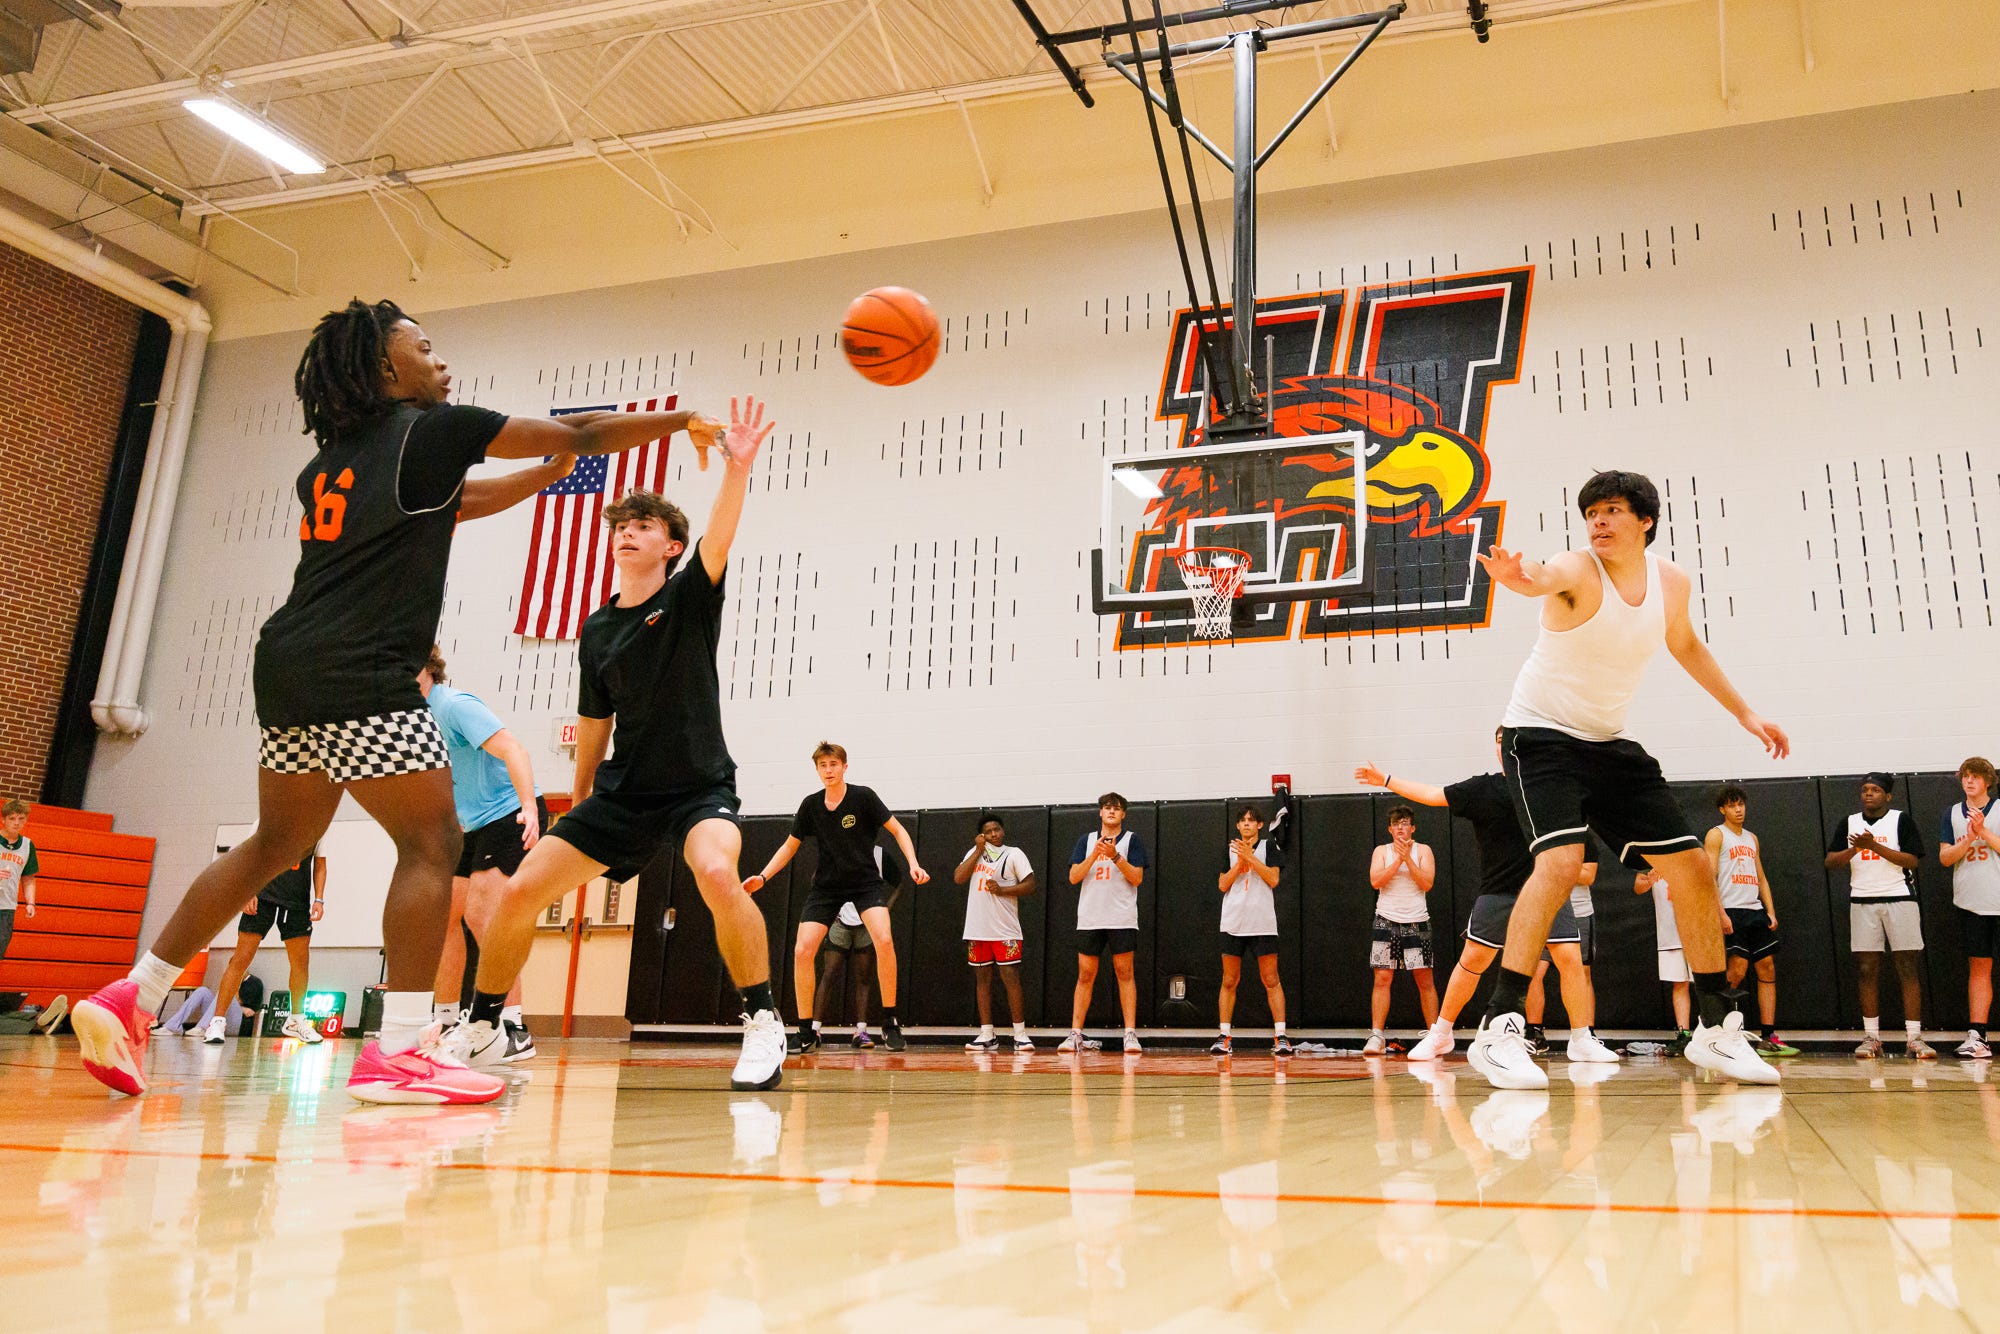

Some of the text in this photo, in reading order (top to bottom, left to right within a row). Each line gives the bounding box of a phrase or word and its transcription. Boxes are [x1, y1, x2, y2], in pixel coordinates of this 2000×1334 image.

[562, 725, 577, 742] EXI
[1729, 845, 1757, 860] HANOVE
[1966, 845, 1989, 862] 25
[1095, 866, 1111, 881] 21
[274, 1010, 290, 1018] HOM
[326, 1018, 338, 1033] 0
